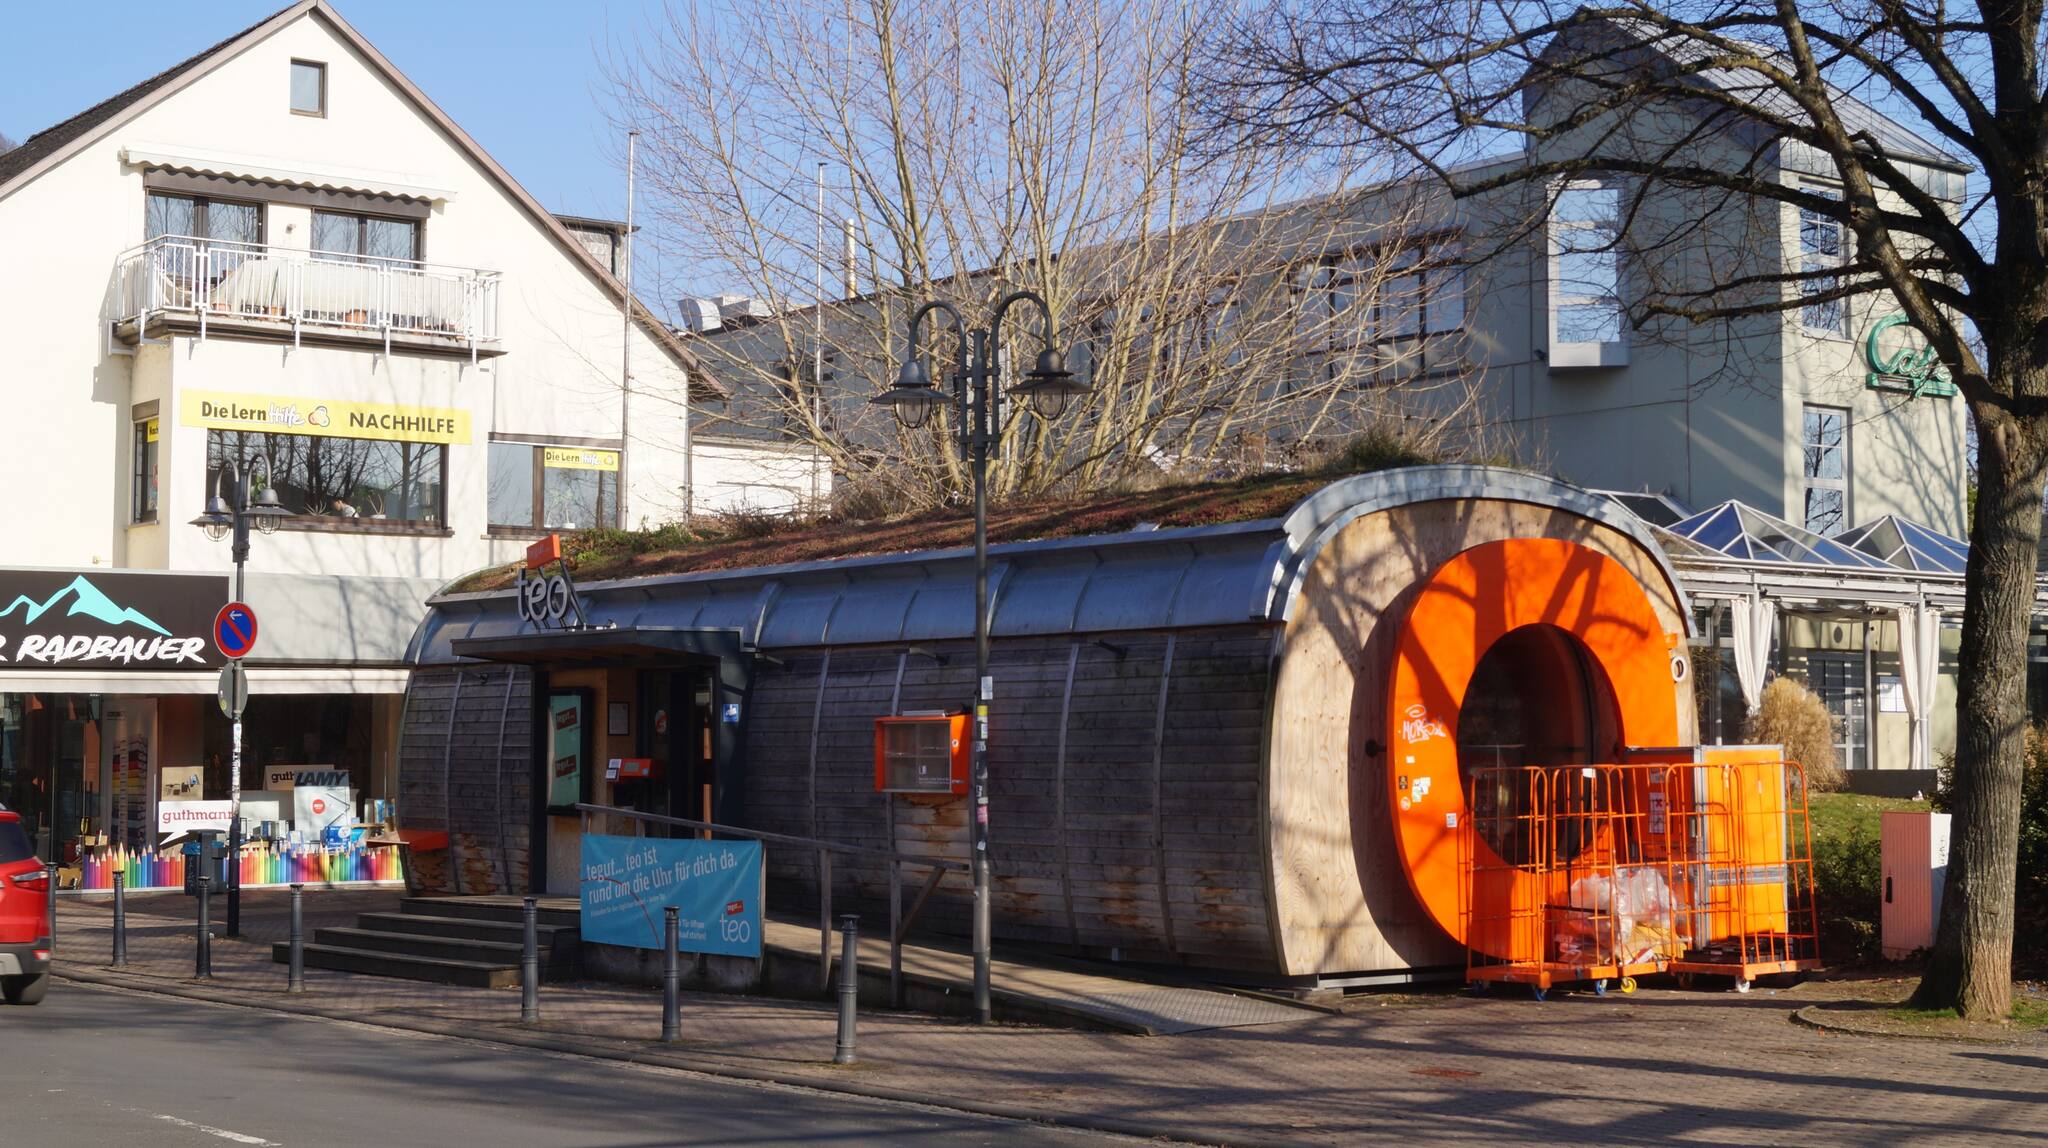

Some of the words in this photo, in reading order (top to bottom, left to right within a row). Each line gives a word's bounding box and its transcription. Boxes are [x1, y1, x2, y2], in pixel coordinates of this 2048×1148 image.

[349, 412, 455, 434] NACHHILFE
[514, 568, 568, 622] teo
[16, 634, 207, 665] RADBAUER
[295, 771, 347, 787] LAMY
[586, 859, 624, 882] tegut...
[626, 853, 642, 871] teo
[644, 846, 657, 866] ist
[588, 881, 612, 905] rund
[615, 881, 631, 897] um
[633, 873, 650, 893] die
[651, 868, 673, 888] Uhr
[675, 861, 690, 883] für
[693, 852, 717, 877] dich
[720, 849, 738, 870] da.
[719, 913, 751, 943] teo
